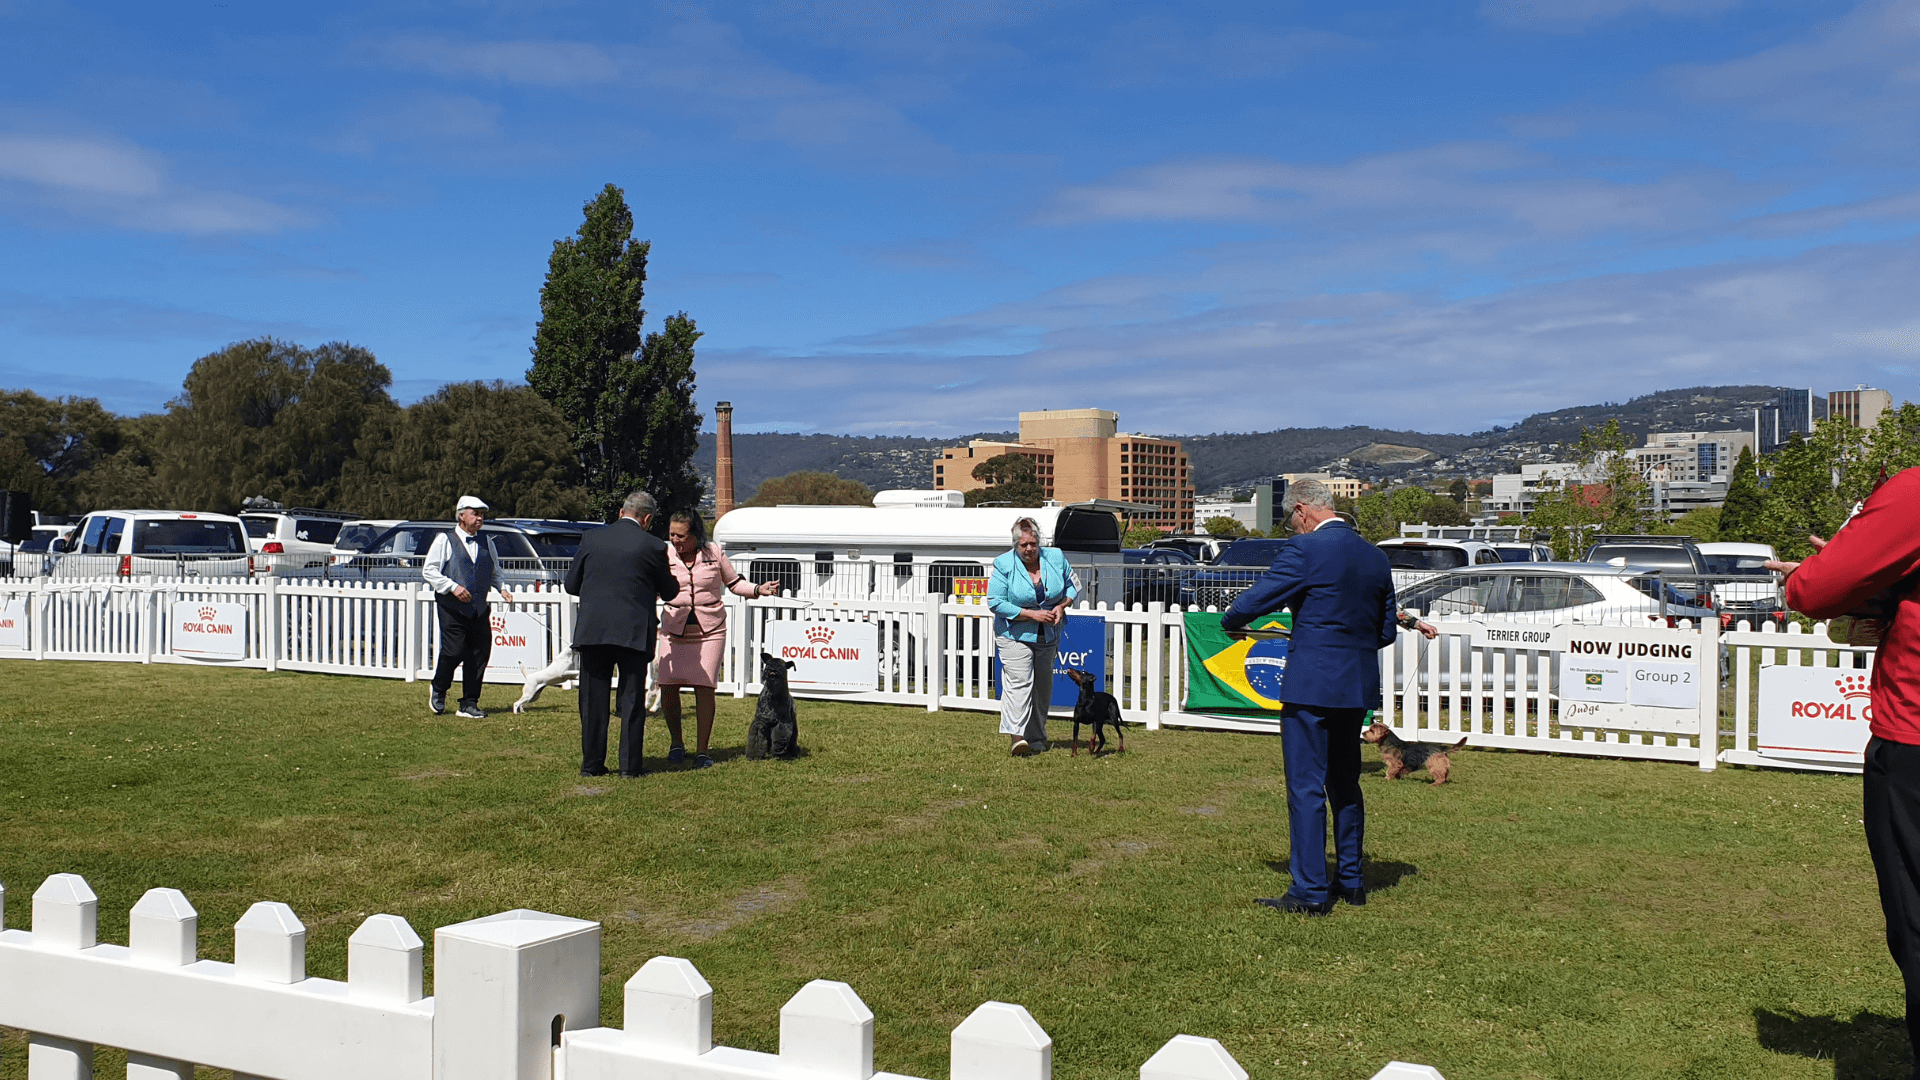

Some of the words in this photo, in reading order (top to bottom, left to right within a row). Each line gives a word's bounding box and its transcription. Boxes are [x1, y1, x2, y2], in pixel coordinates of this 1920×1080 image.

[183, 622, 205, 633] ROYAL
[206, 623, 233, 635] CANIN
[494, 635, 526, 647] CANIN
[1487, 629, 1519, 641] TERRIER
[1522, 631, 1550, 643] GROUP
[782, 646, 817, 659] ROYAL
[820, 647, 859, 660] CANIN
[1570, 640, 1612, 655] NOW
[1617, 642, 1692, 659] JUDGING
[1055, 651, 1087, 667] ver
[1635, 669, 1678, 685] Group
[1683, 671, 1691, 684] 2
[1566, 704, 1600, 717] Judge
[1791, 701, 1856, 720] ROYAL
